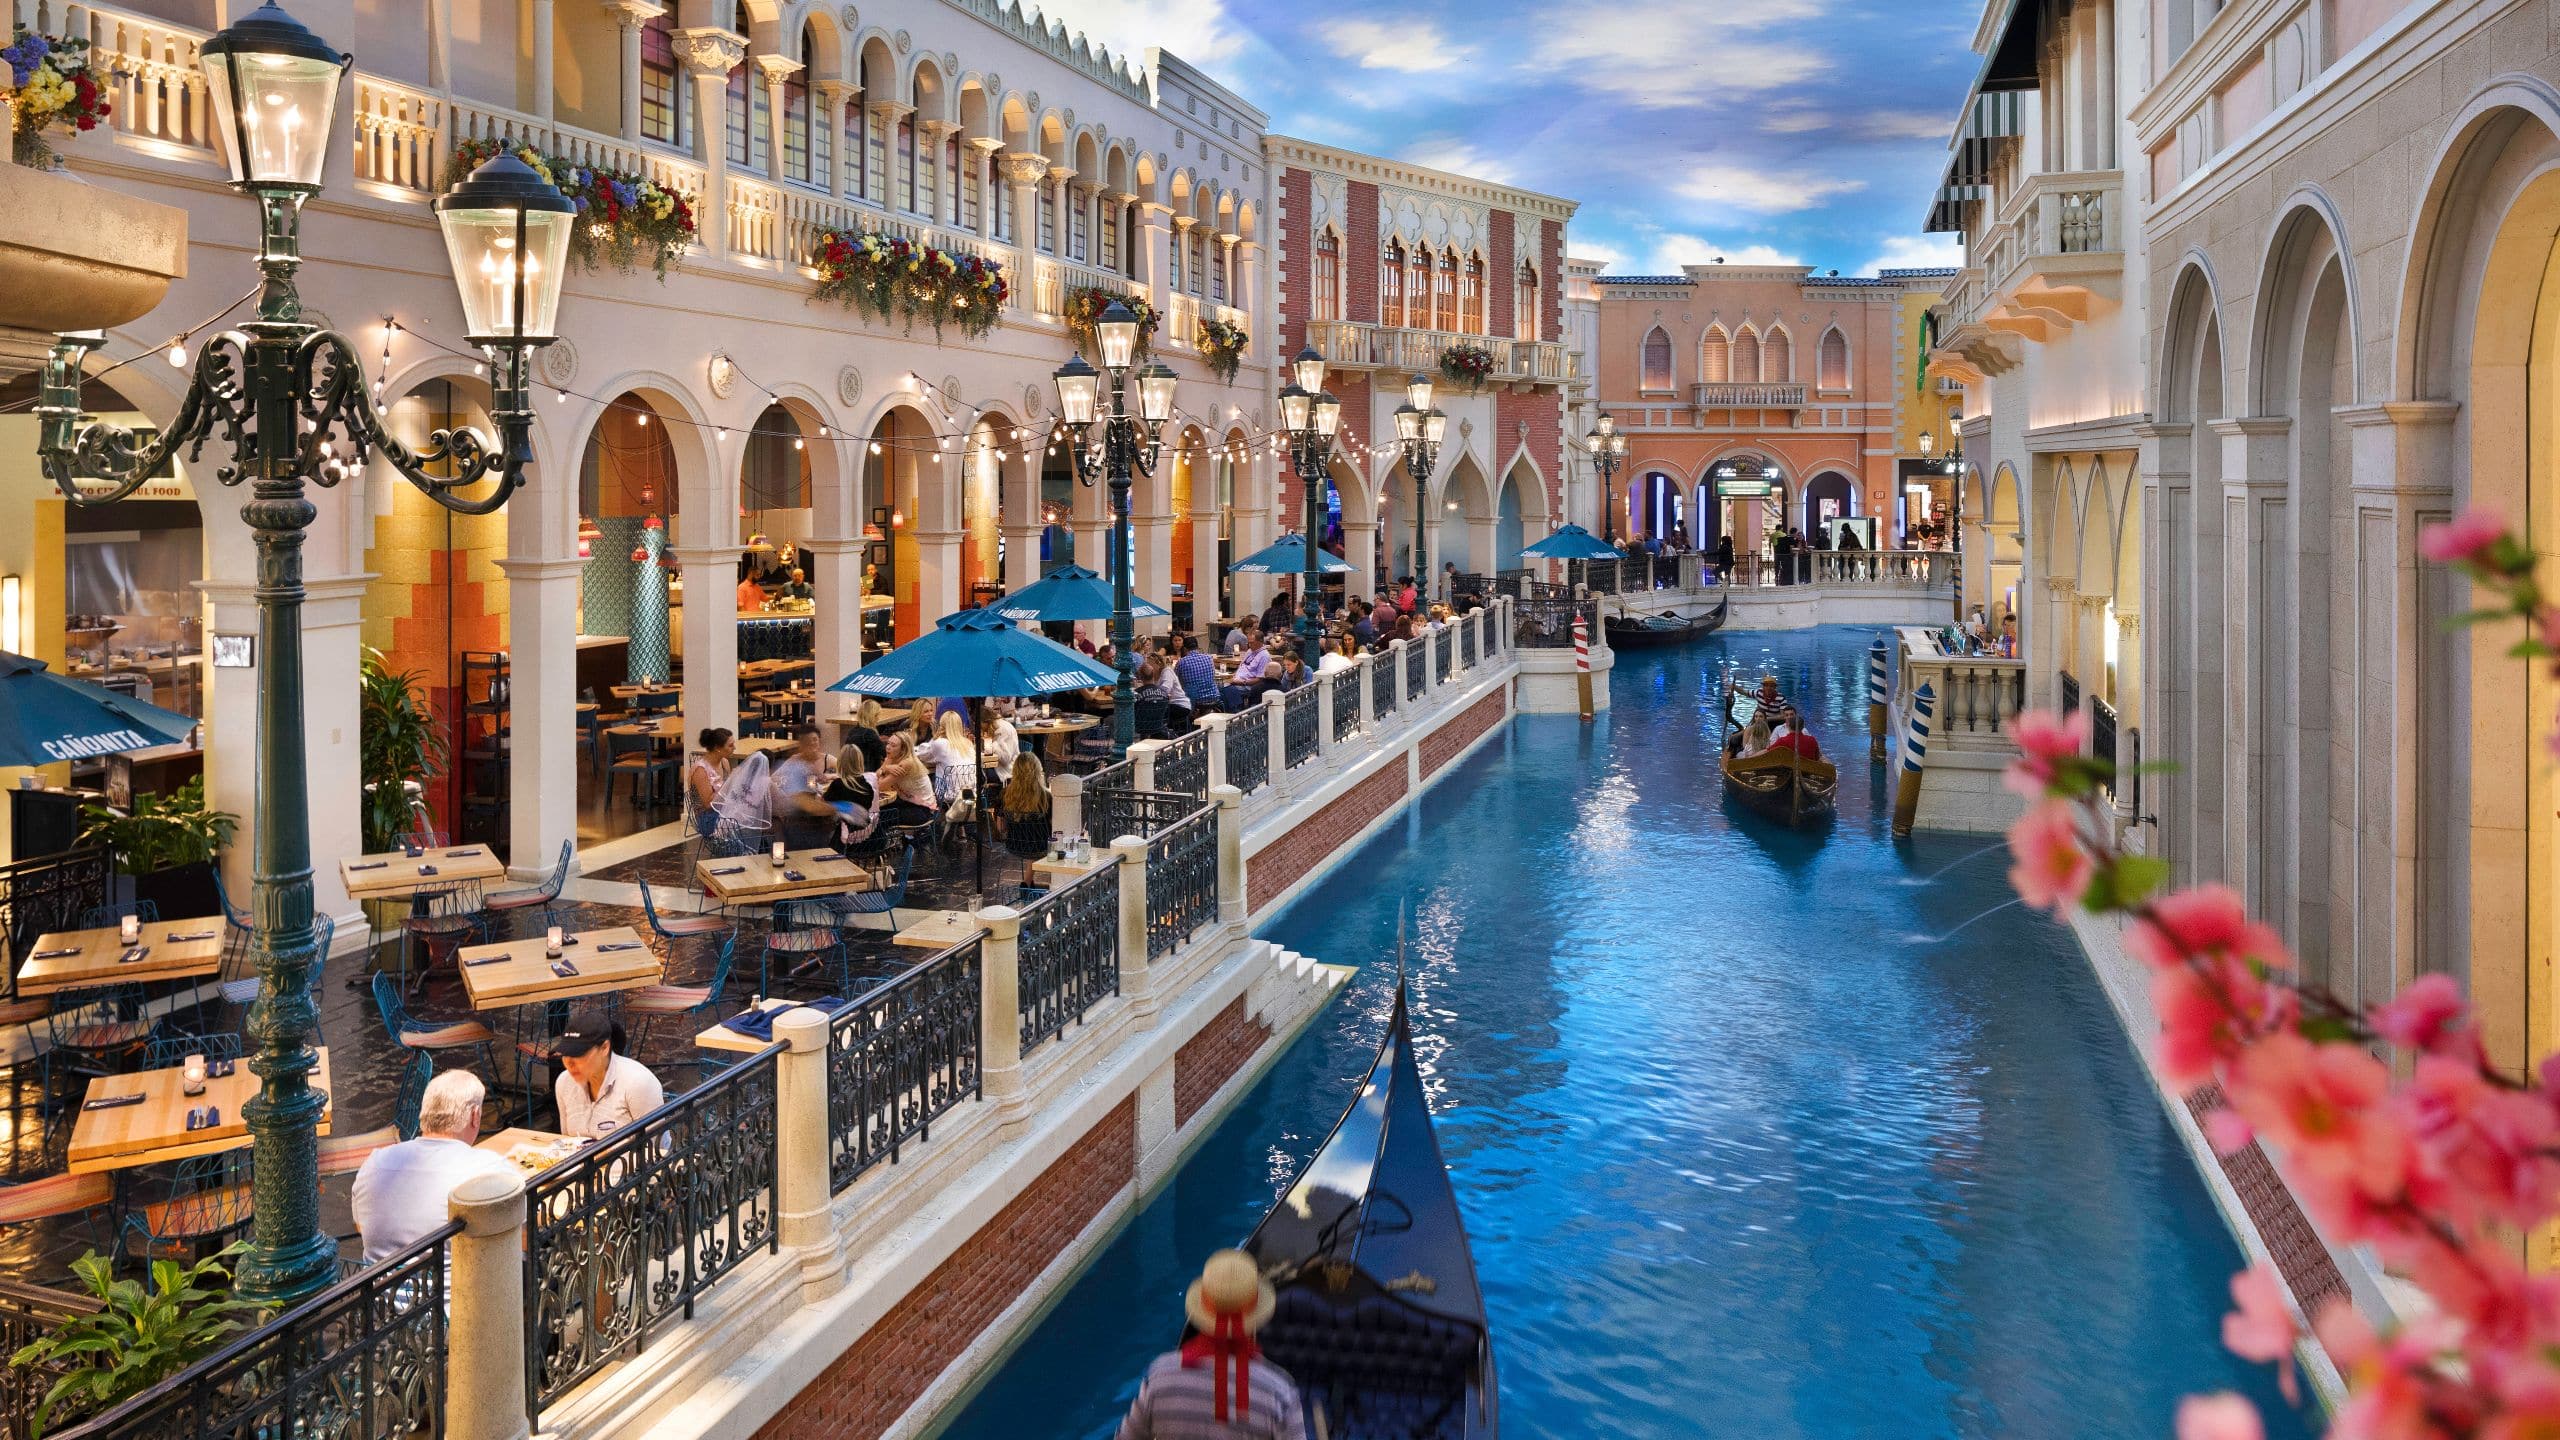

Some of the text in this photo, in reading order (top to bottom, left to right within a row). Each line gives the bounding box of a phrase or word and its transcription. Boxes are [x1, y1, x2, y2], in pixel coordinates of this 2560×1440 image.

[97, 487, 113, 495] CIT
[153, 487, 181, 496] FOOD
[844, 672, 905, 695] CAÑONITA
[41, 729, 151, 760] CAÑONITA
